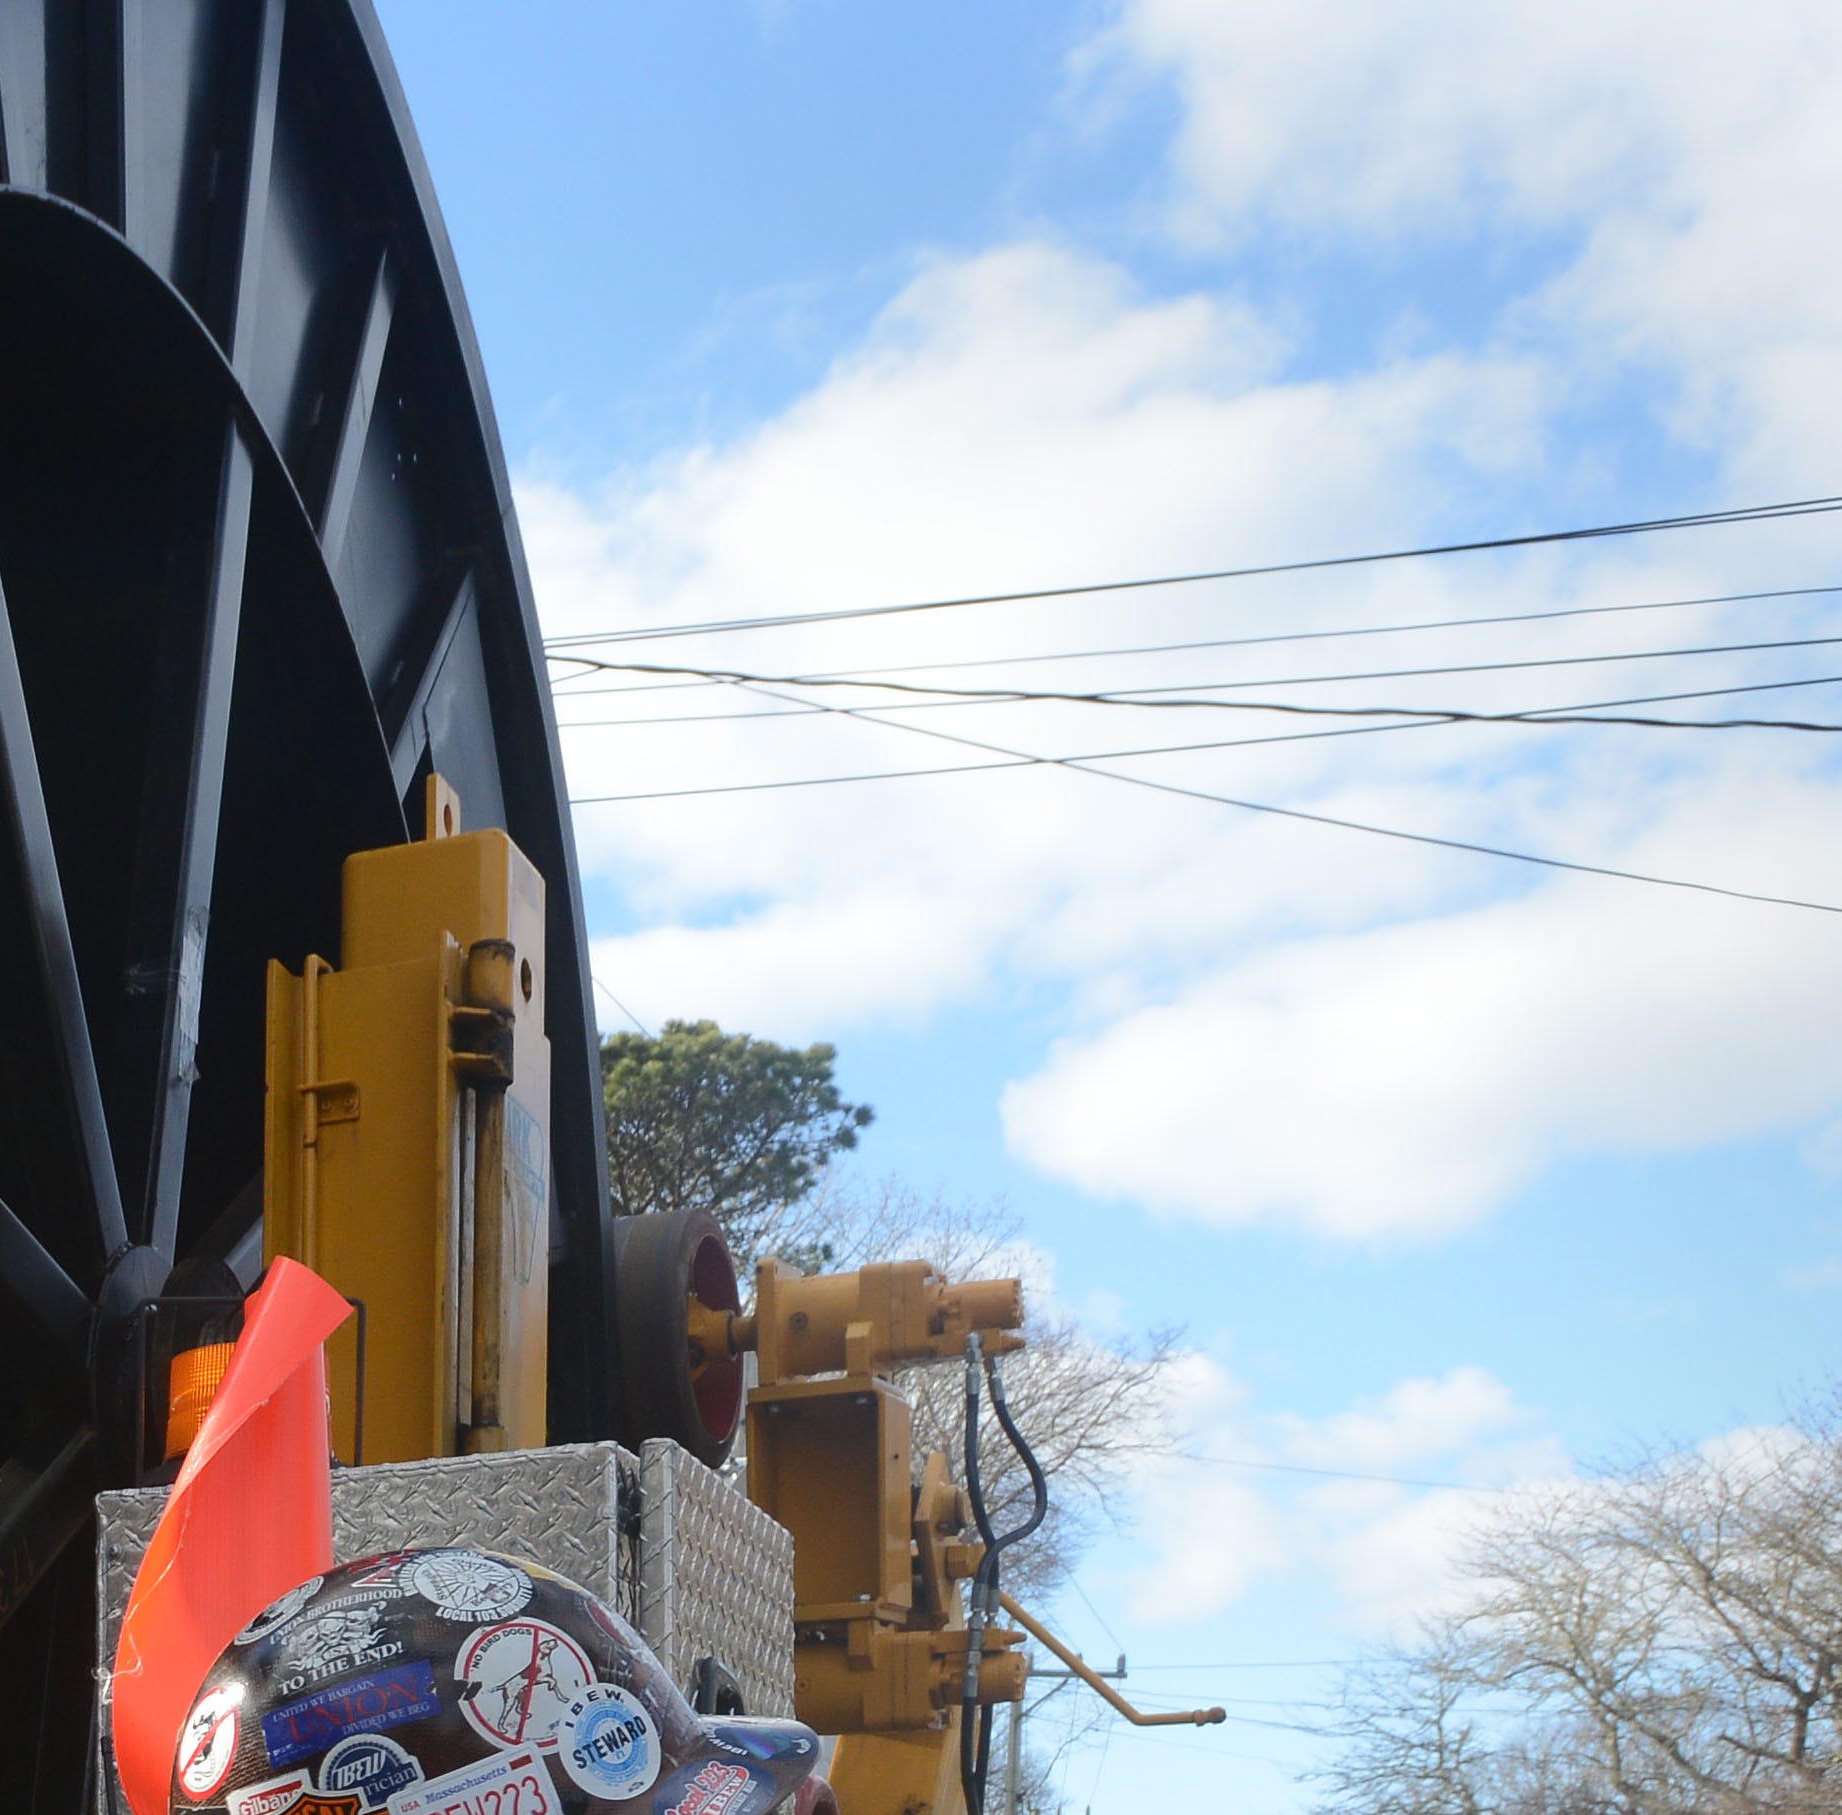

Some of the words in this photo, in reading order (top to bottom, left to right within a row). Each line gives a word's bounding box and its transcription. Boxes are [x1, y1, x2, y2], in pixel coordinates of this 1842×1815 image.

[305, 1588, 403, 1619] BROTHERHOOD
[435, 1606, 474, 1622] LOCAL
[480, 1634, 501, 1655] BIRD
[502, 1628, 533, 1638] DOGS
[278, 1675, 305, 1696] TO
[308, 1656, 350, 1683] THE
[354, 1641, 404, 1668] END!
[273, 1702, 309, 1723] UNITED
[309, 1696, 326, 1708] WE
[328, 1680, 376, 1702] BARGAIN
[287, 1674, 420, 1744] UNION
[342, 1714, 387, 1736] DIVIDED
[387, 1706, 407, 1719] WE
[407, 1701, 430, 1716] BEG
[572, 1715, 648, 1769] STEWARD
[332, 1750, 387, 1790] IBEW
[366, 1766, 417, 1796] rician
[694, 1761, 732, 1791] 223
[400, 1800, 421, 1813] USA
[424, 1765, 508, 1805] Massachusetts
